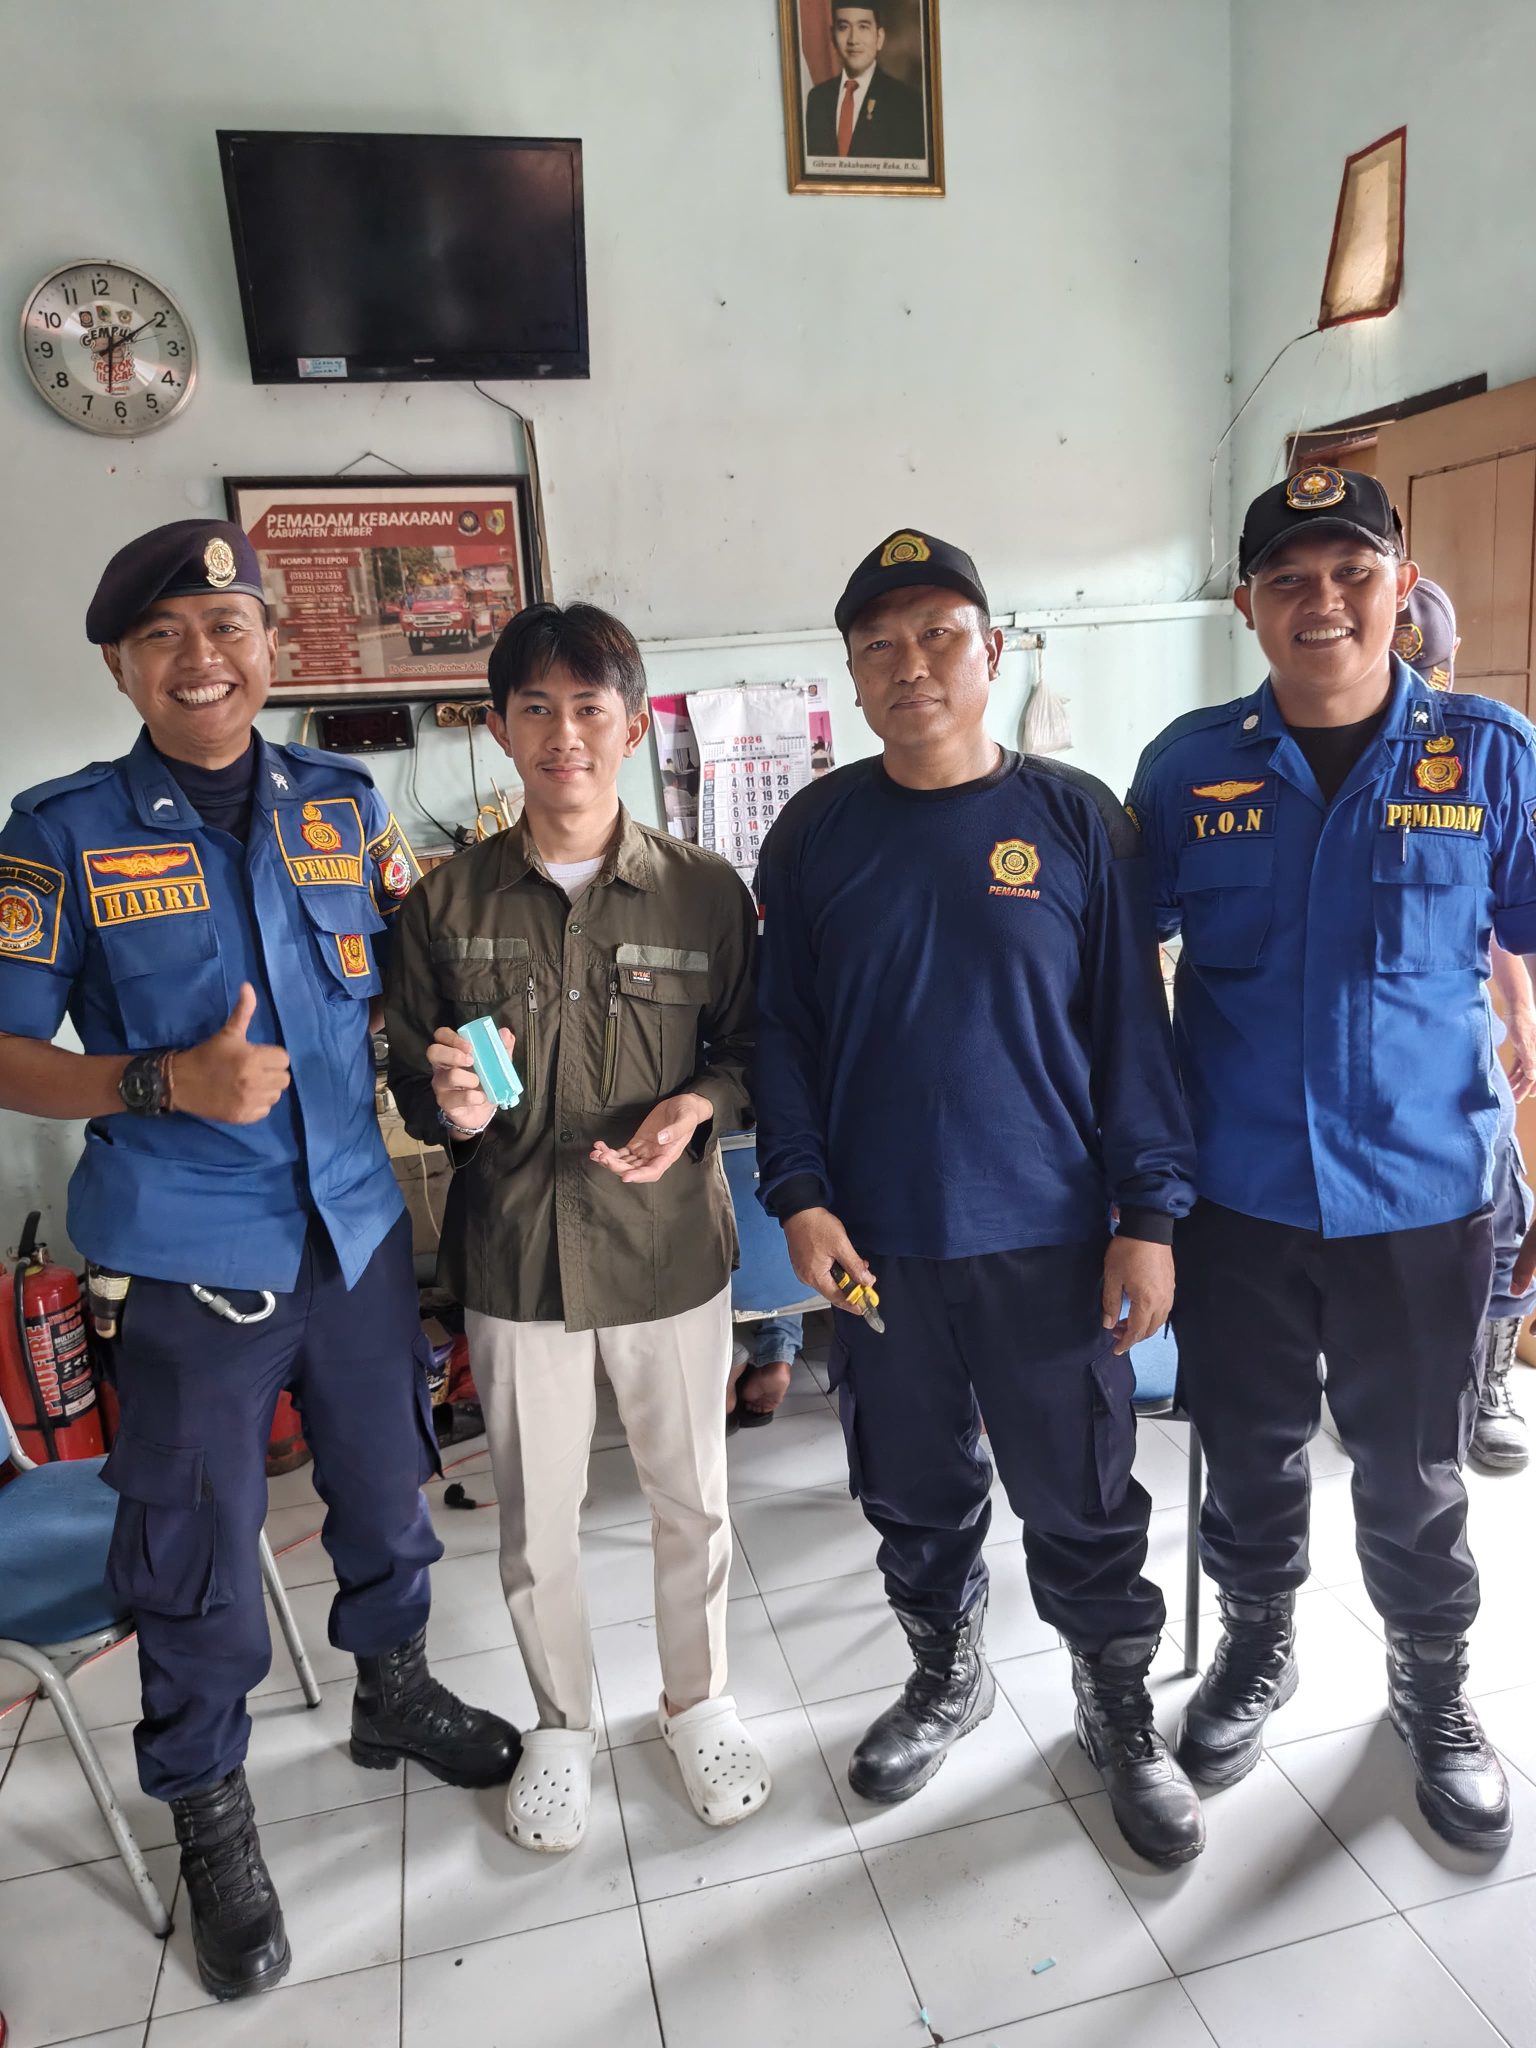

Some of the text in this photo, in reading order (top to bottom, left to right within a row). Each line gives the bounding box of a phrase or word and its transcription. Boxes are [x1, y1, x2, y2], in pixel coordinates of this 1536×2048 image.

[91, 279, 110, 296] 12
[64, 288, 78, 305] 11
[132, 288, 138, 304] 1
[44, 312, 62, 329] 10
[153, 311, 167, 328] 2
[40, 341, 54, 359] 9
[166, 340, 179, 357] 3
[56, 371, 69, 388] 8
[160, 370, 175, 387] 4
[81, 395, 94, 411] 7
[114, 401, 127, 418] 6
[146, 394, 158, 409] 5
[266, 511, 454, 529] PEMADAM KEBAKARAN
[267, 526, 373, 538] KABUPATEN JEMBER
[280, 556, 349, 565] NOMOR TELEPON
[734, 735, 762, 745] 2026
[731, 762, 736, 774] 3
[744, 761, 754, 774] 10
[761, 761, 770, 773] 17
[731, 775, 789, 788] 4 11 18 25
[732, 789, 789, 804] 5 12 19 26
[733, 807, 739, 818] 6
[747, 806, 757, 817] 13
[762, 805, 774, 816] 20
[1387, 802, 1483, 833] PEMADAM
[735, 821, 740, 833] 7
[748, 820, 758, 832] 14
[1193, 807, 1264, 840] Y.O.N
[721, 835, 760, 848] 1 8 15
[736, 850, 742, 861] 9
[750, 849, 760, 860] 16
[988, 885, 1041, 900] PEMADAM
[101, 884, 199, 921] HARRY
